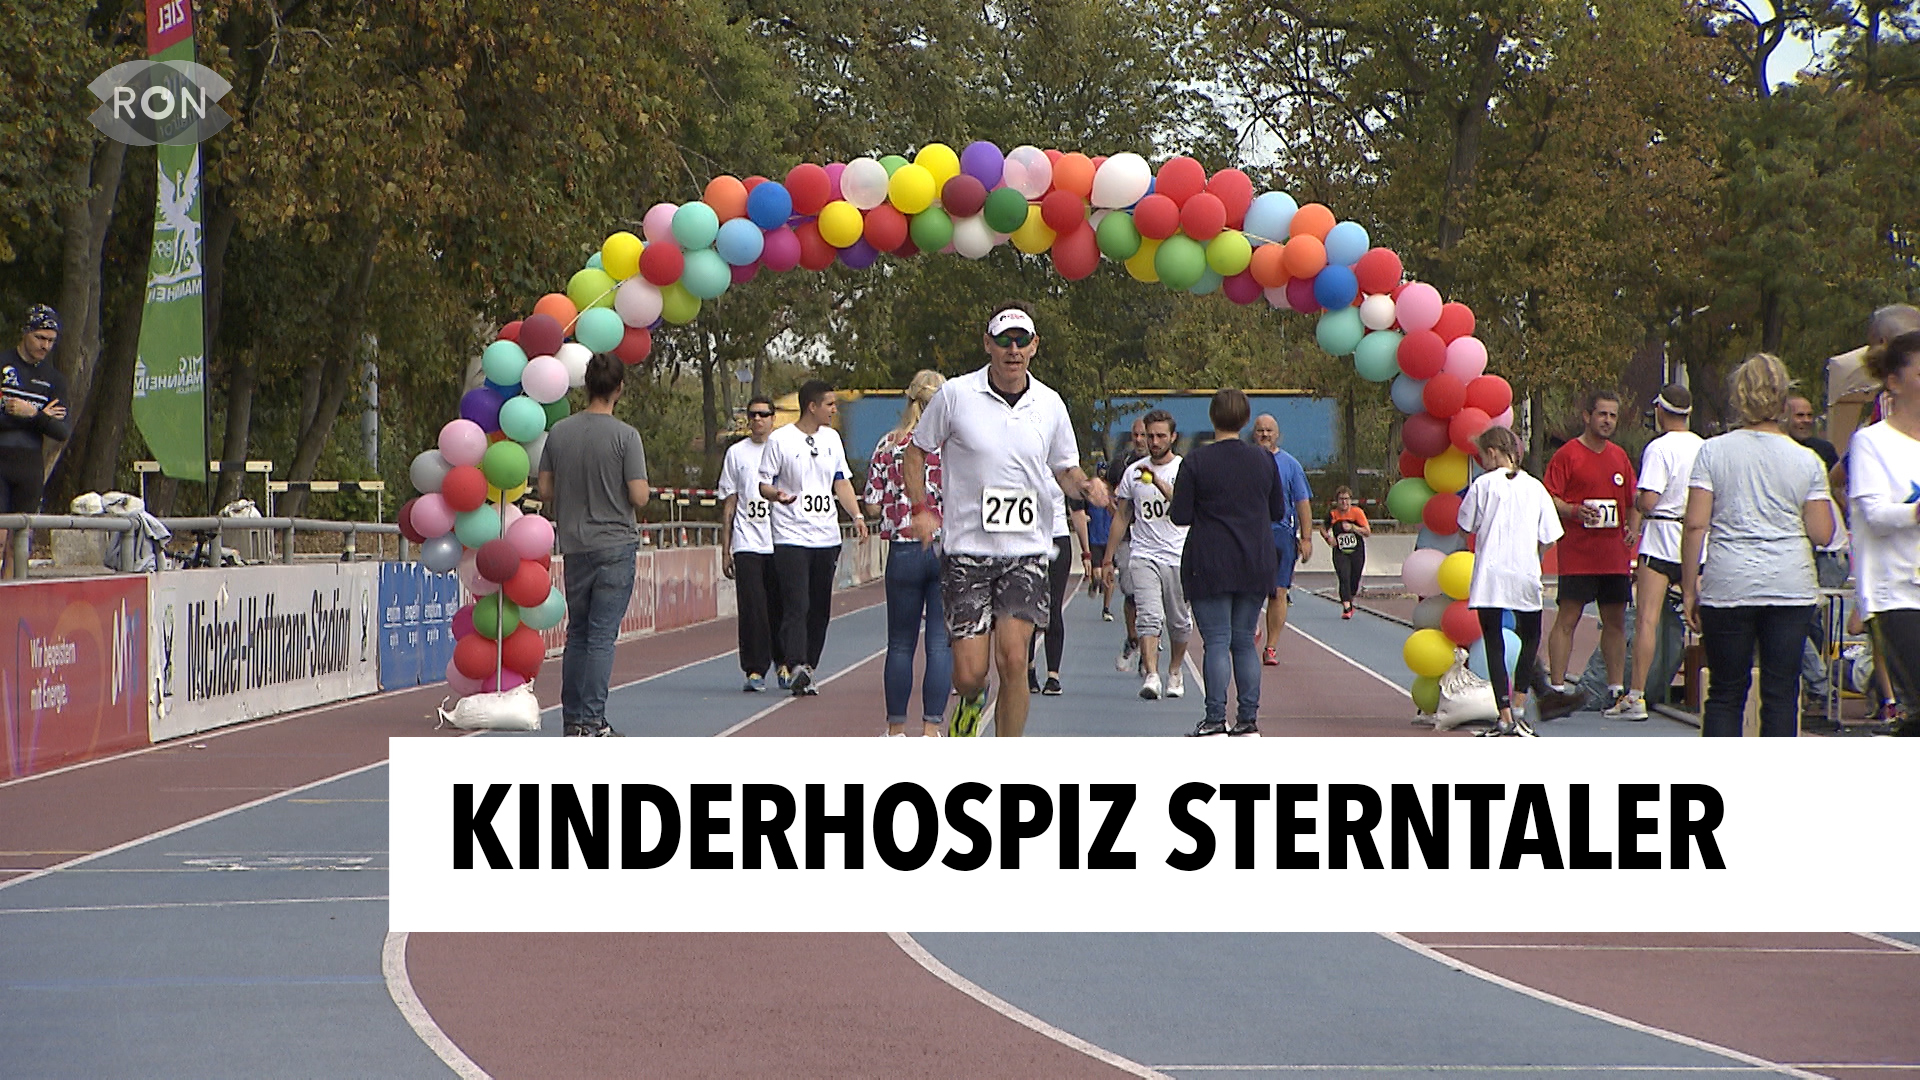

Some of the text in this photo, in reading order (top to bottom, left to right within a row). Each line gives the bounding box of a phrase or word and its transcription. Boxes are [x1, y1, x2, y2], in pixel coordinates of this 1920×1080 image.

[747, 500, 771, 519] 35
[803, 494, 831, 513] 303
[986, 496, 1034, 526] 276
[187, 587, 351, 702] Michael-Hoffmann-Stadion
